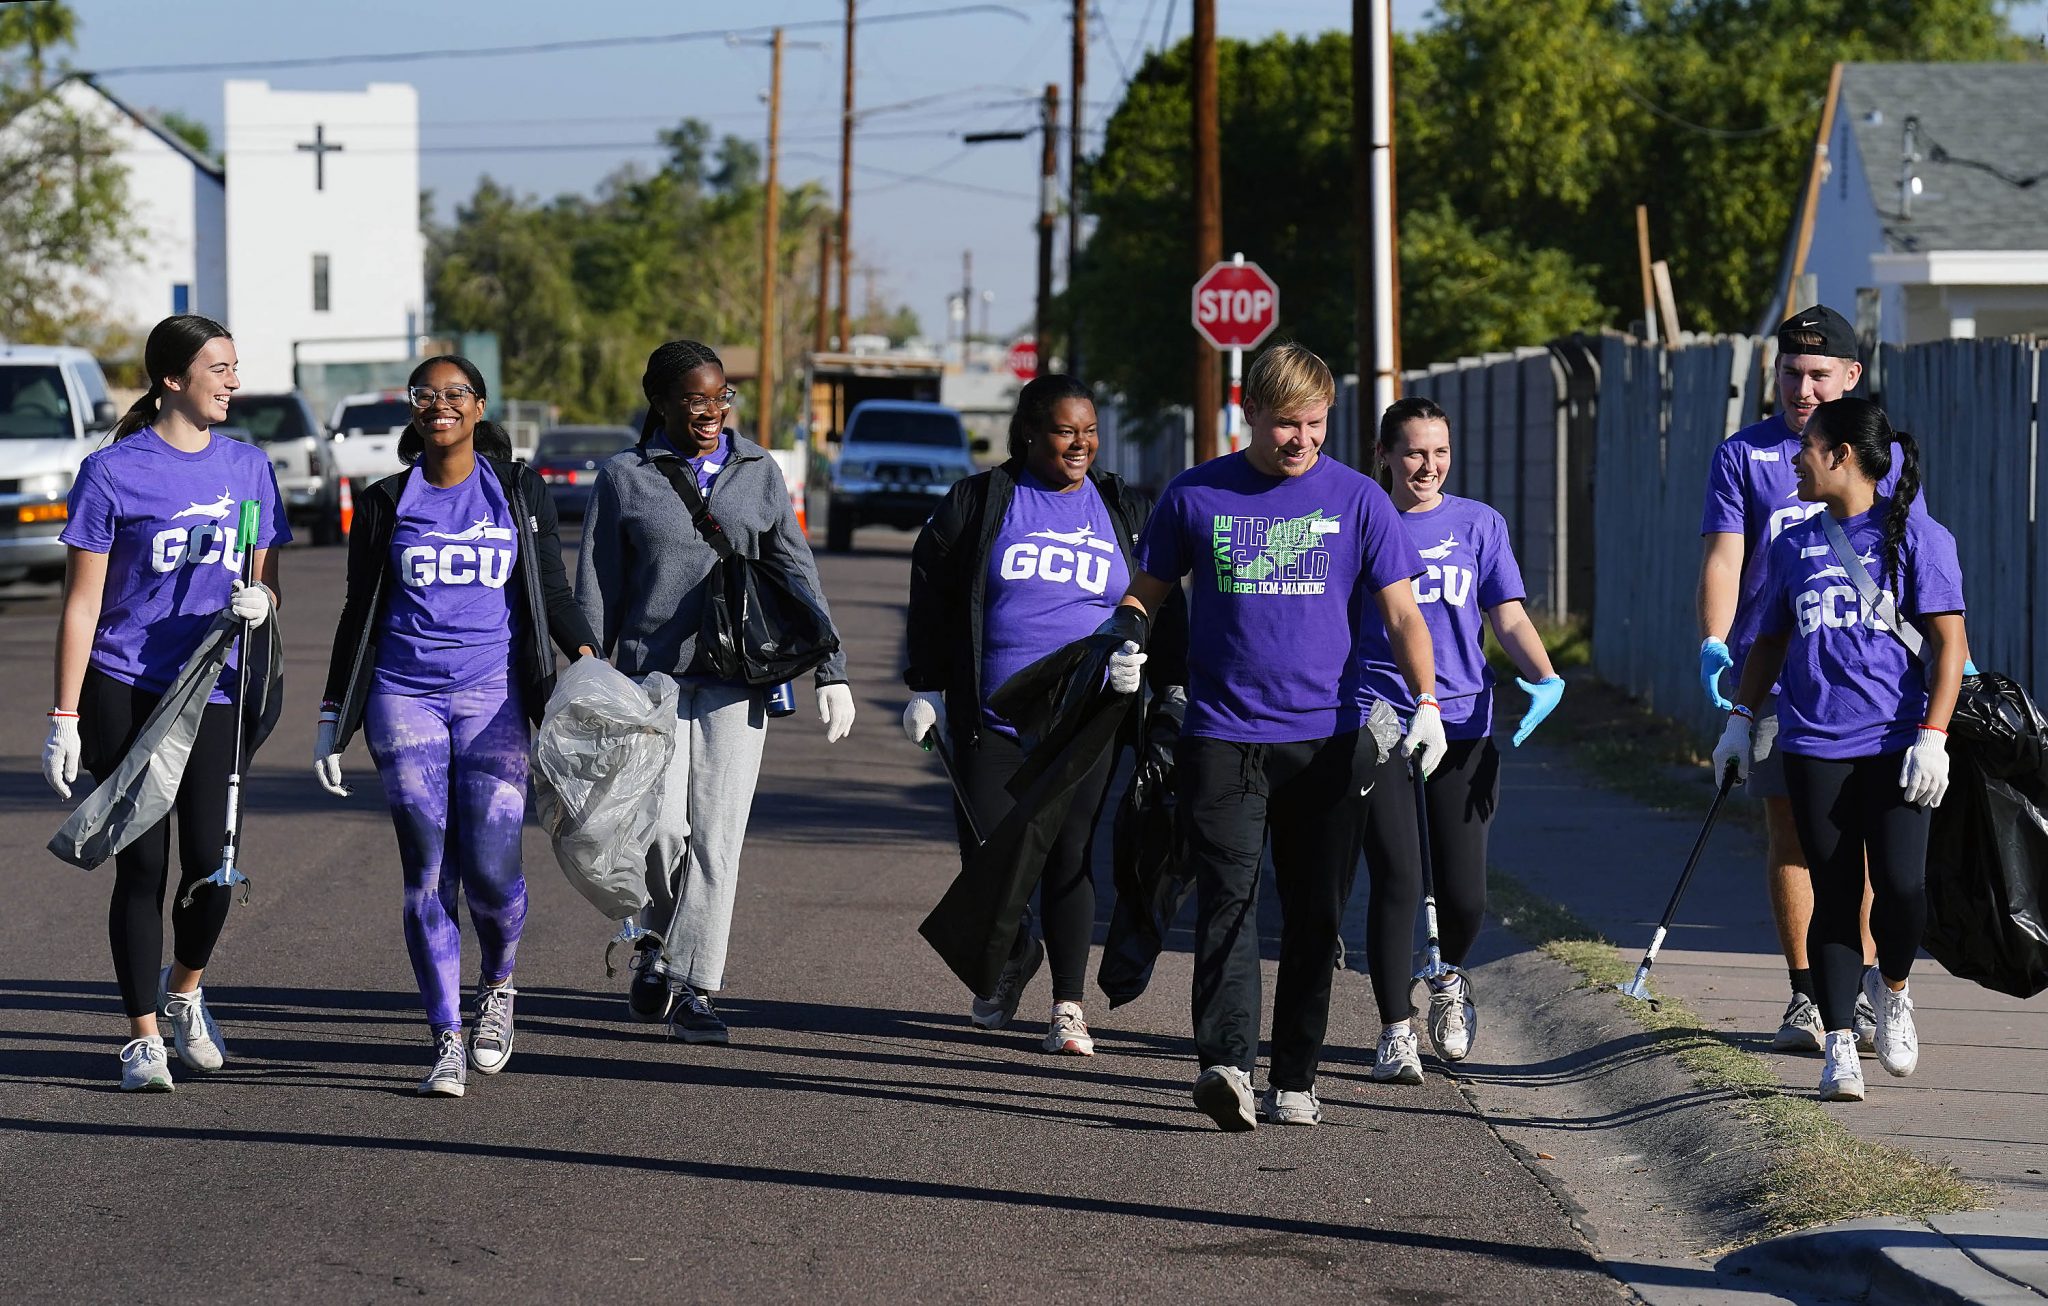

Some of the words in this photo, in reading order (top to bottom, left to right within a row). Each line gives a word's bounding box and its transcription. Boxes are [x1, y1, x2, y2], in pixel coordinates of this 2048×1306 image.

[1200, 288, 1272, 324] STOP
[401, 544, 512, 589] GCU
[1000, 543, 1111, 593] GCU
[1213, 515, 1233, 593] STATE
[1259, 549, 1330, 580] FIELD
[1233, 582, 1256, 594] 2021
